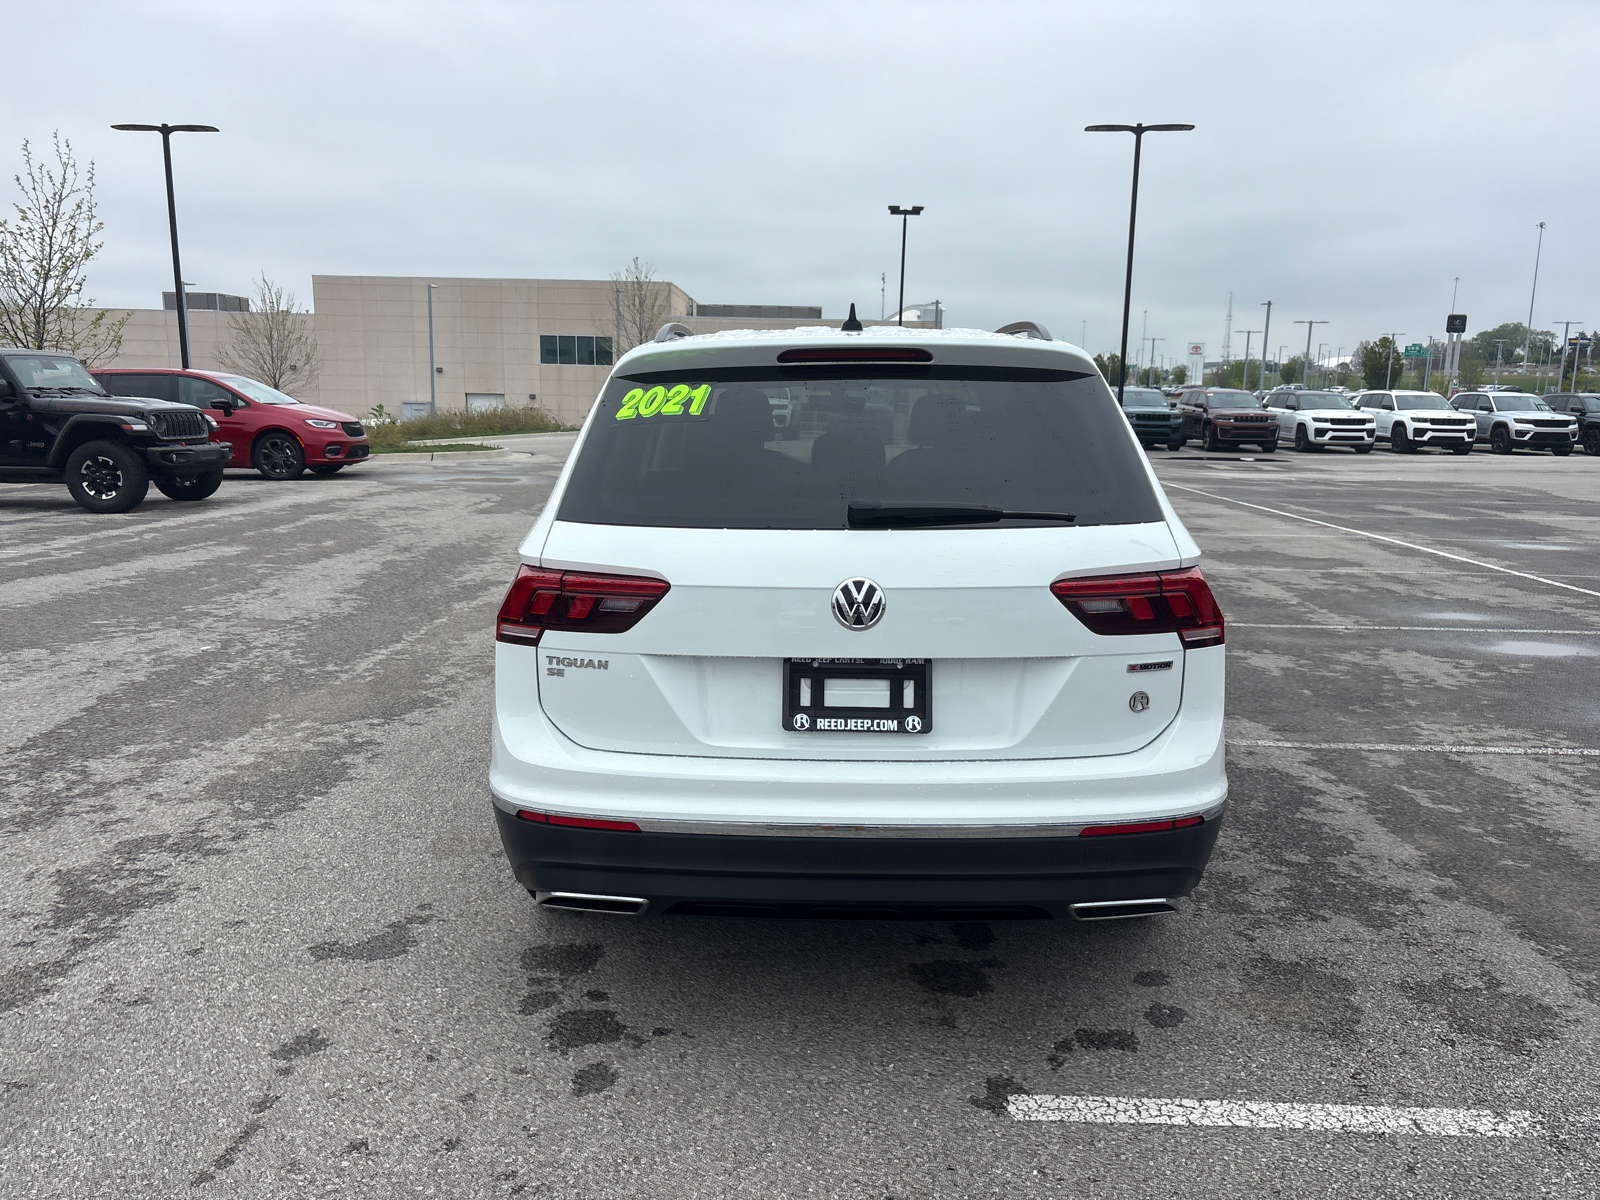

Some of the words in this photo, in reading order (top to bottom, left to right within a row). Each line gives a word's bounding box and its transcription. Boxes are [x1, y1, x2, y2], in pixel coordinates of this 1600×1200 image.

[615, 384, 712, 420] 2021
[831, 576, 886, 632] VW
[546, 655, 609, 670] TIGUAN
[546, 668, 565, 677] SE
[816, 718, 898, 731] REEDJEEP.COM
